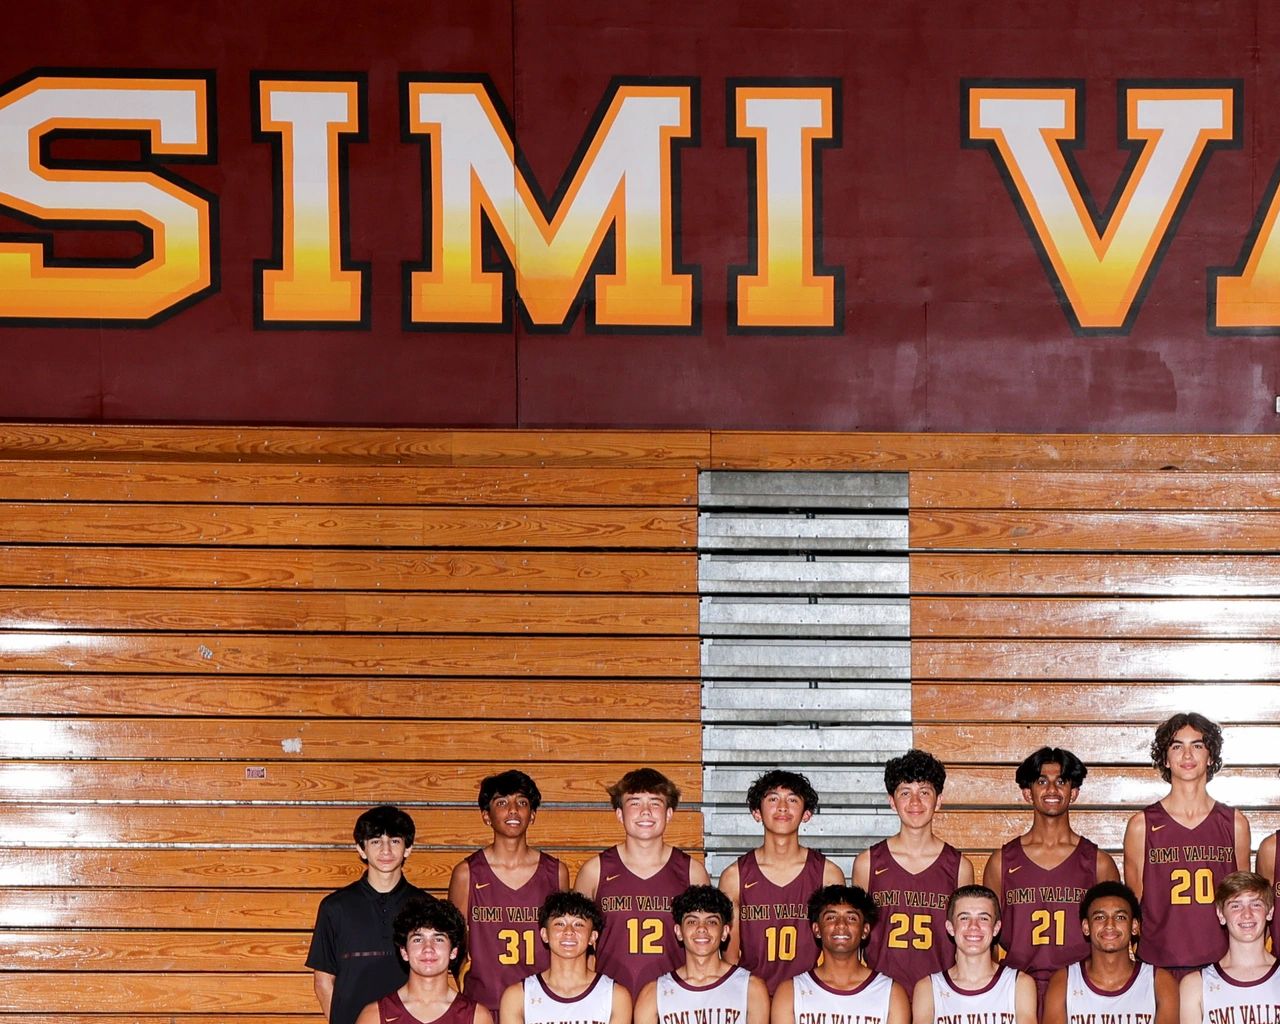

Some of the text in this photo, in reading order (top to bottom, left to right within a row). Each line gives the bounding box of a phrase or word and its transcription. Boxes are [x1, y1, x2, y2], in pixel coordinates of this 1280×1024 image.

[0, 70, 843, 334] SIMI
[1149, 846, 1233, 863] SIMI VALLEY
[601, 896, 671, 911] SIMI VALL
[904, 890, 949, 908] VALLE
[1007, 889, 1037, 905] SIMI
[1171, 868, 1215, 905] 20
[472, 906, 505, 922] SIMI
[741, 904, 809, 920] SIMI VALL
[1031, 910, 1065, 946] 21
[499, 930, 535, 965] 31
[627, 918, 664, 954] 12
[765, 926, 797, 961] 10
[888, 913, 932, 950] 25
